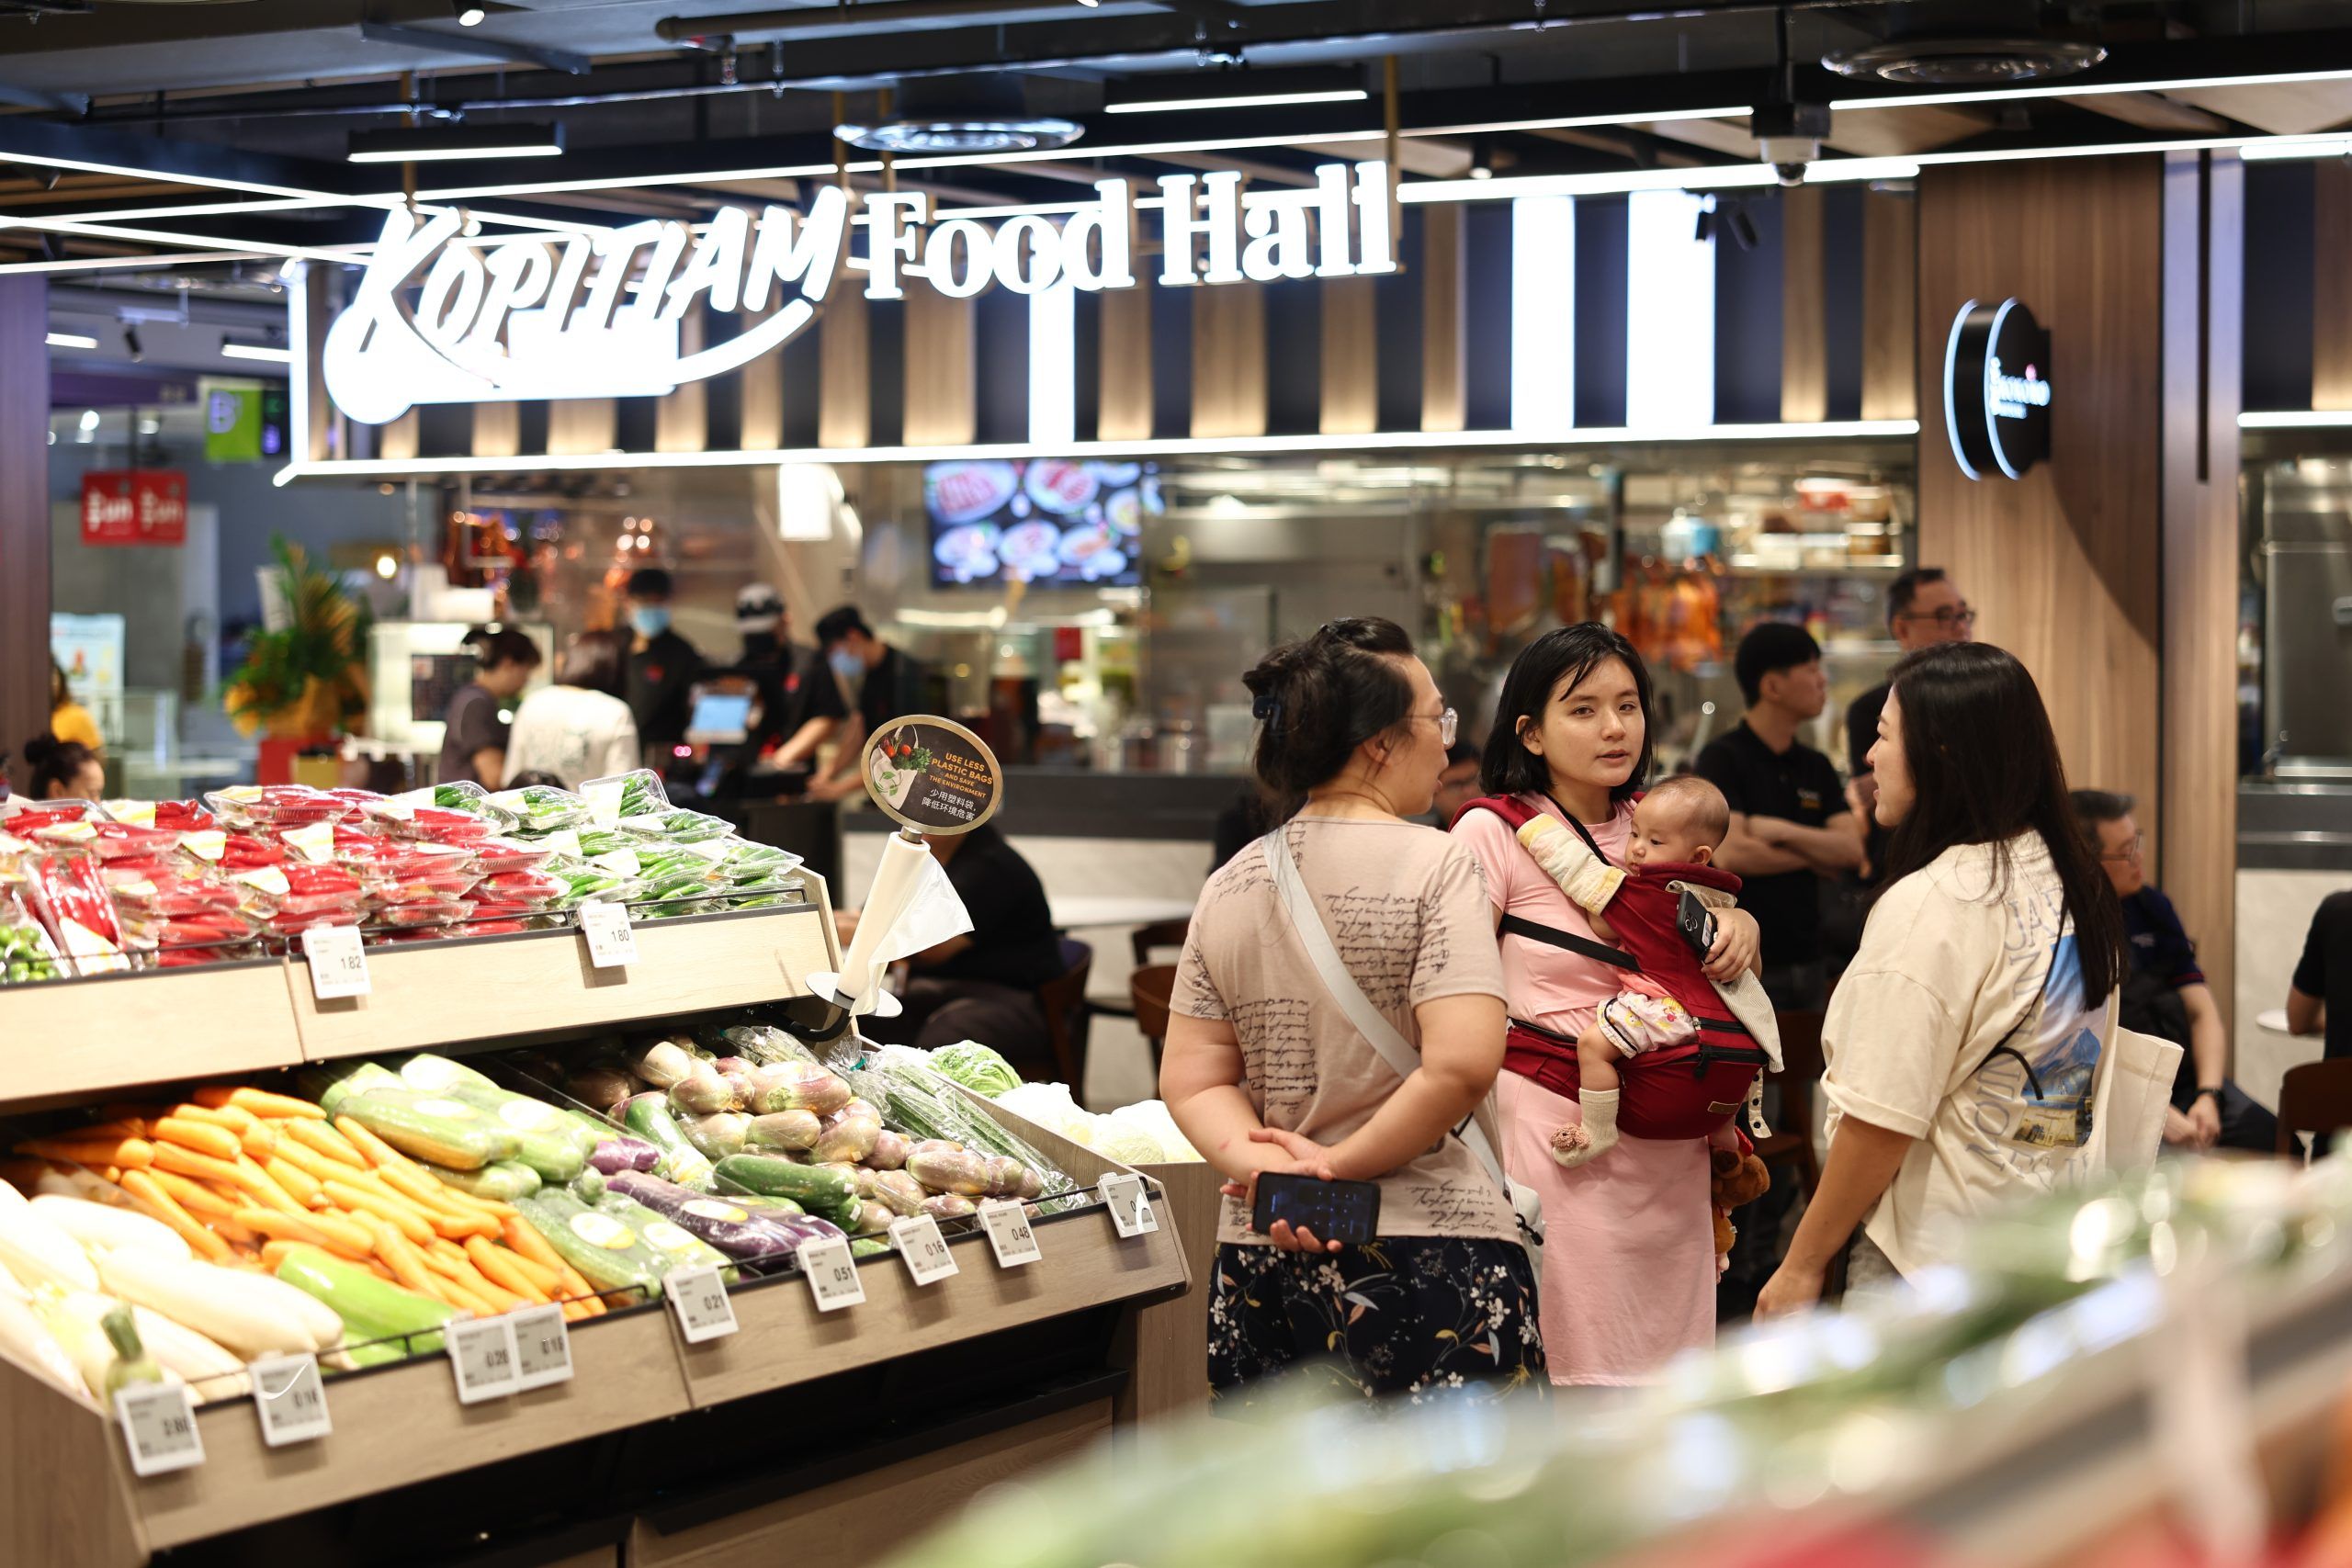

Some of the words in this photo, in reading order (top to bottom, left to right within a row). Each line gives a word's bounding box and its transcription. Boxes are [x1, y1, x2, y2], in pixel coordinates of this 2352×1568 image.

[356, 185, 847, 360] KOPITIAM
[864, 177, 1136, 299] Food
[1158, 160, 1398, 286] Hall
[931, 758, 968, 776] PLASTIC
[969, 771, 993, 784] BAGS
[945, 752, 963, 764] USE
[964, 759, 985, 772] LESS
[929, 774, 941, 784] THE
[942, 779, 987, 798] ENVIRONMENT
[944, 773, 958, 781] AND
[959, 777, 975, 786] SAVE
[922, 796, 976, 821] 降低环境危害
